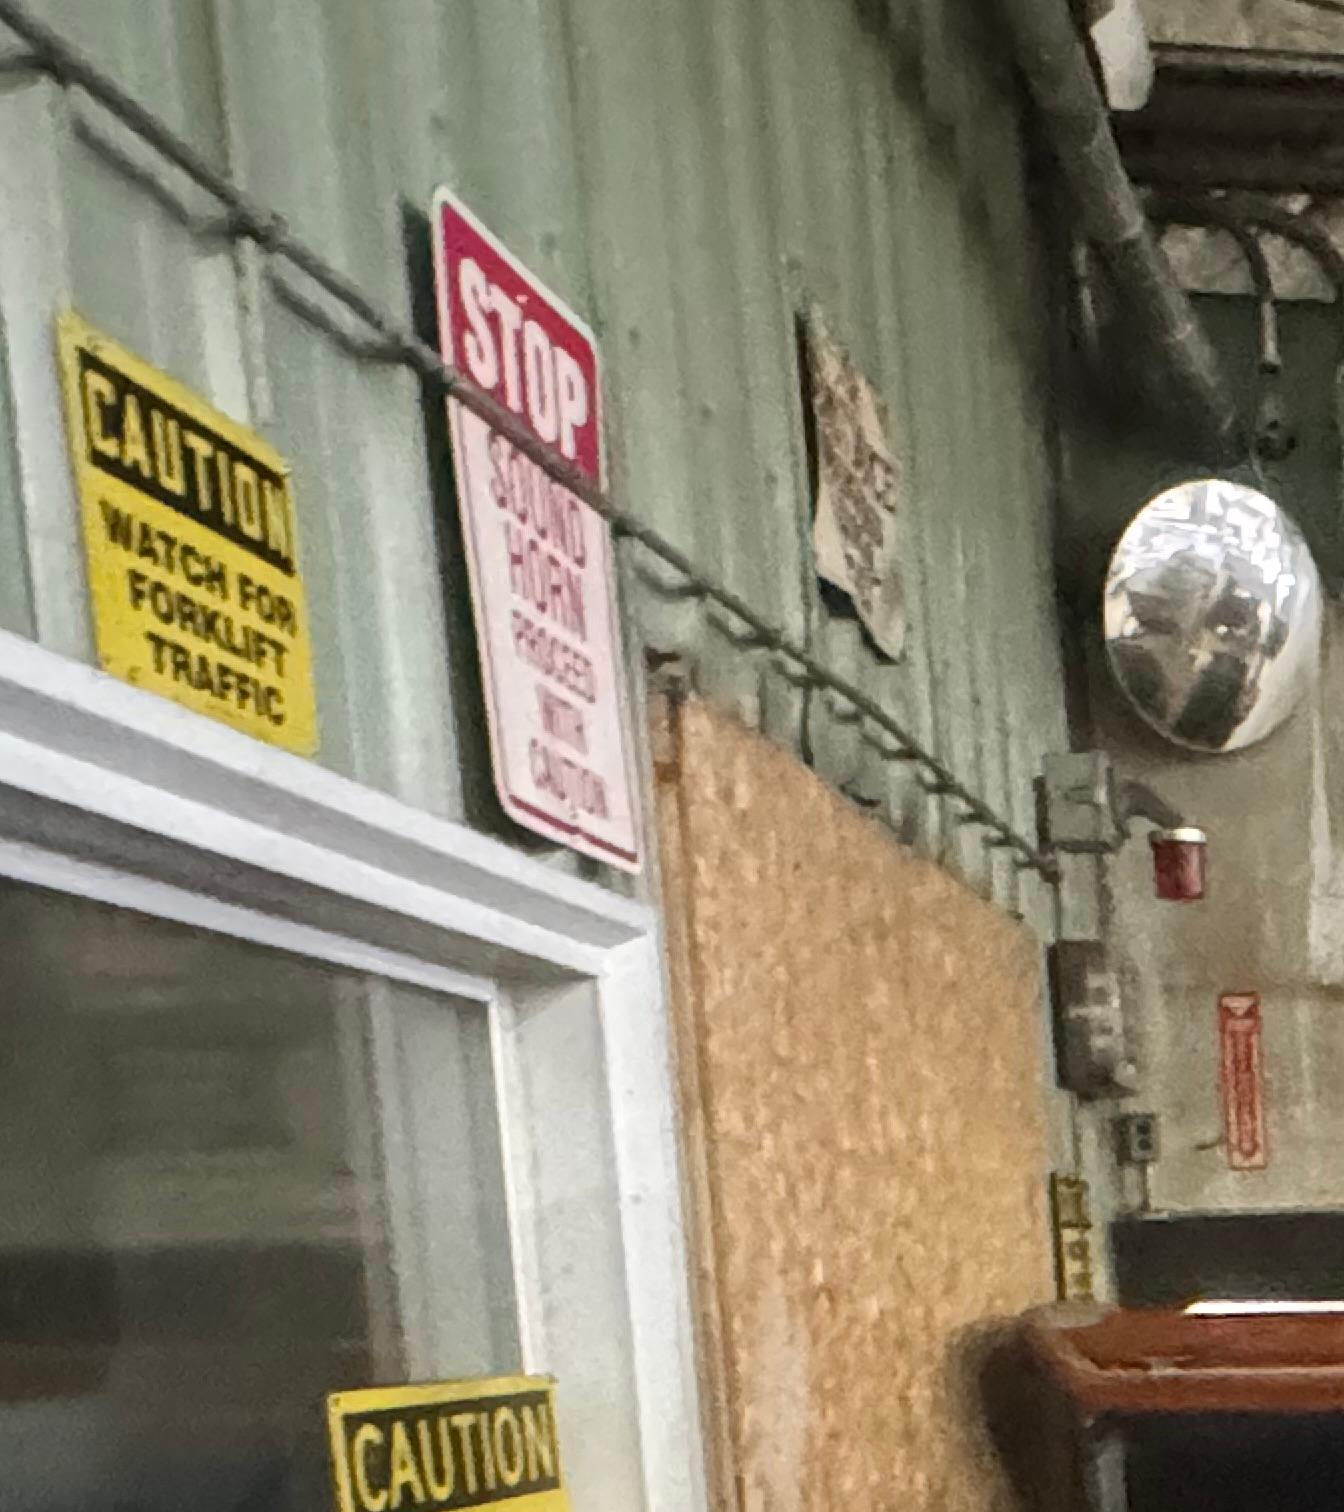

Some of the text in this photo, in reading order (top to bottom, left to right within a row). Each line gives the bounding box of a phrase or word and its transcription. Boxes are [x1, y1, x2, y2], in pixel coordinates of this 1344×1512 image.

[459, 258, 587, 460] STOP
[84, 368, 293, 558] CAUTION
[99, 499, 299, 638] WATCH FOR
[128, 569, 289, 679] FORKLIFT
[144, 632, 285, 726] TRAFFIC
